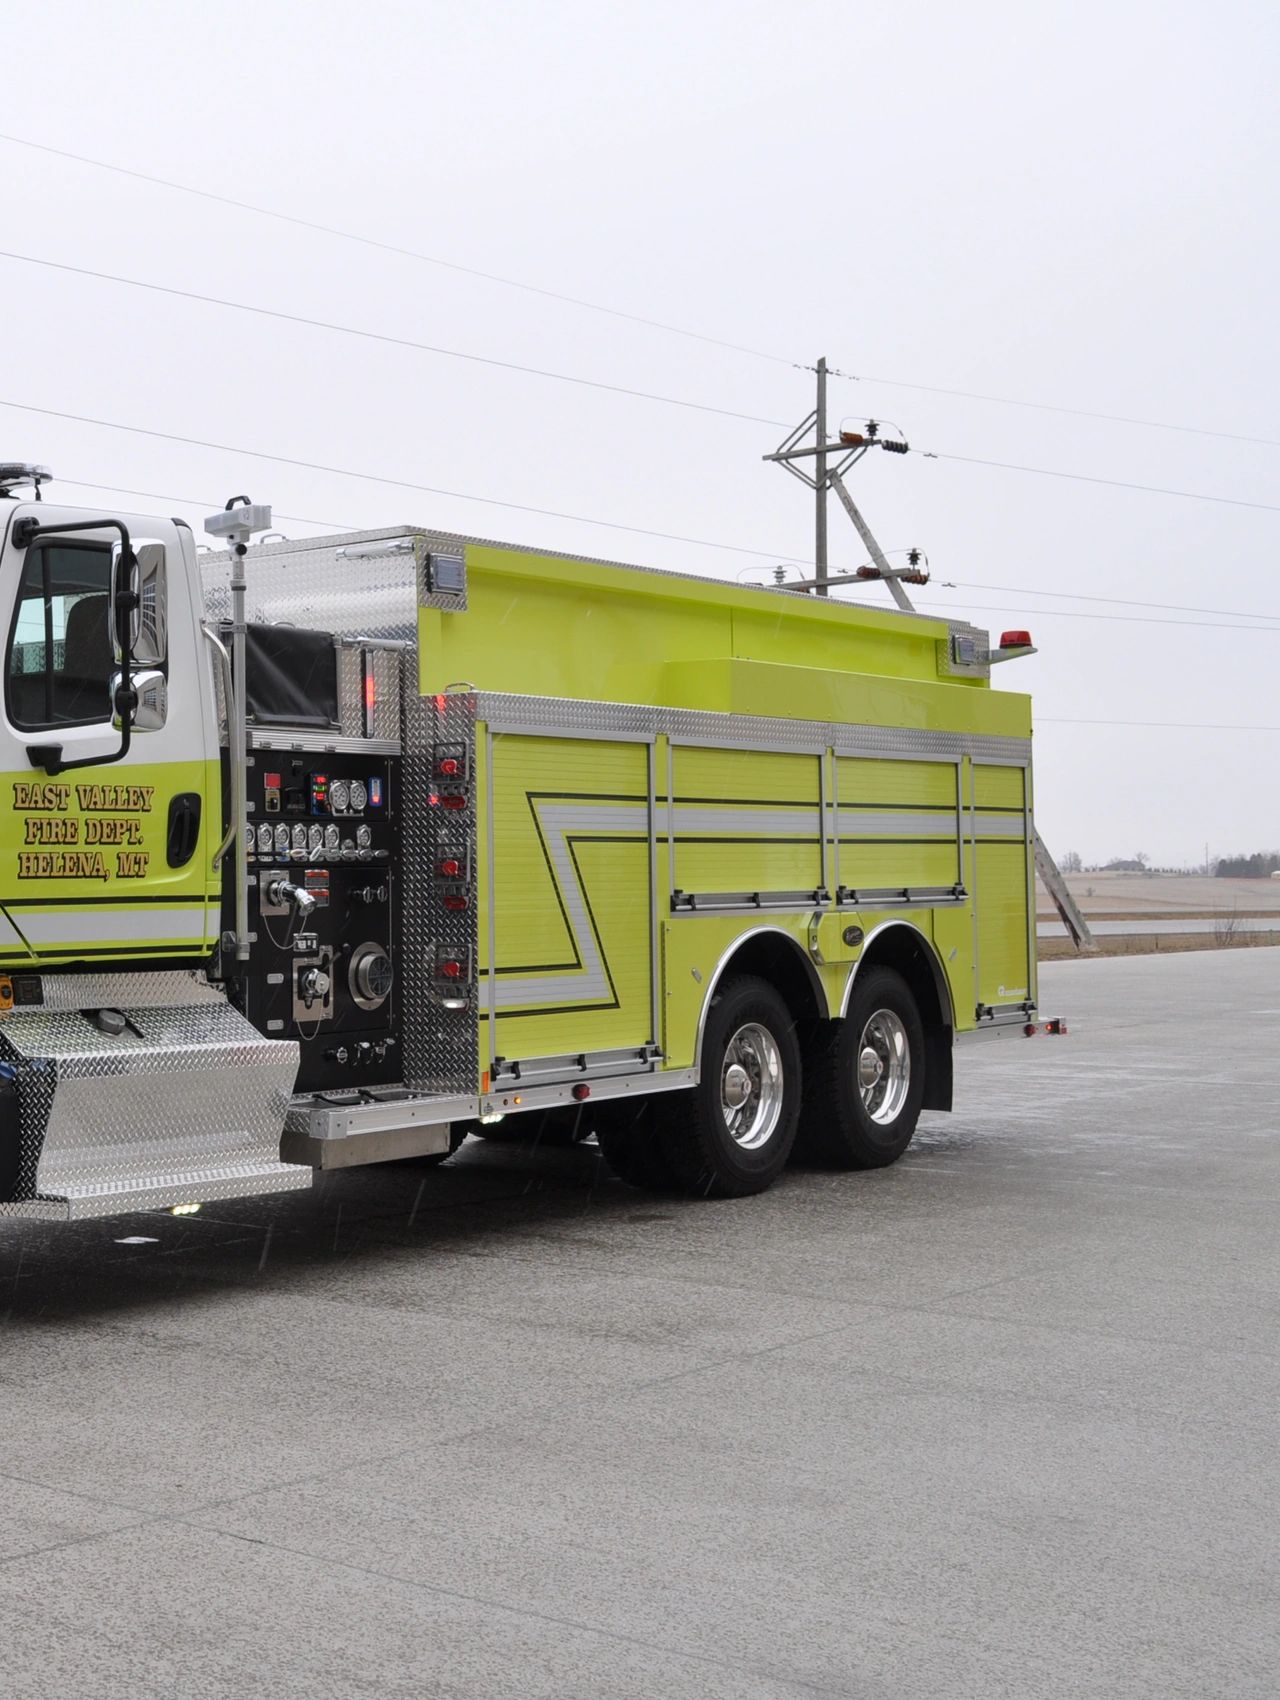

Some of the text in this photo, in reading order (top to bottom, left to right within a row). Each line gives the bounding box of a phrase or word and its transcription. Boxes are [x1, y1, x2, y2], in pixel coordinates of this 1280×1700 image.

[13, 783, 154, 812] EAST VALLEY
[24, 817, 144, 845] FIRE DEPT.
[18, 852, 149, 882] HELENA, MT
